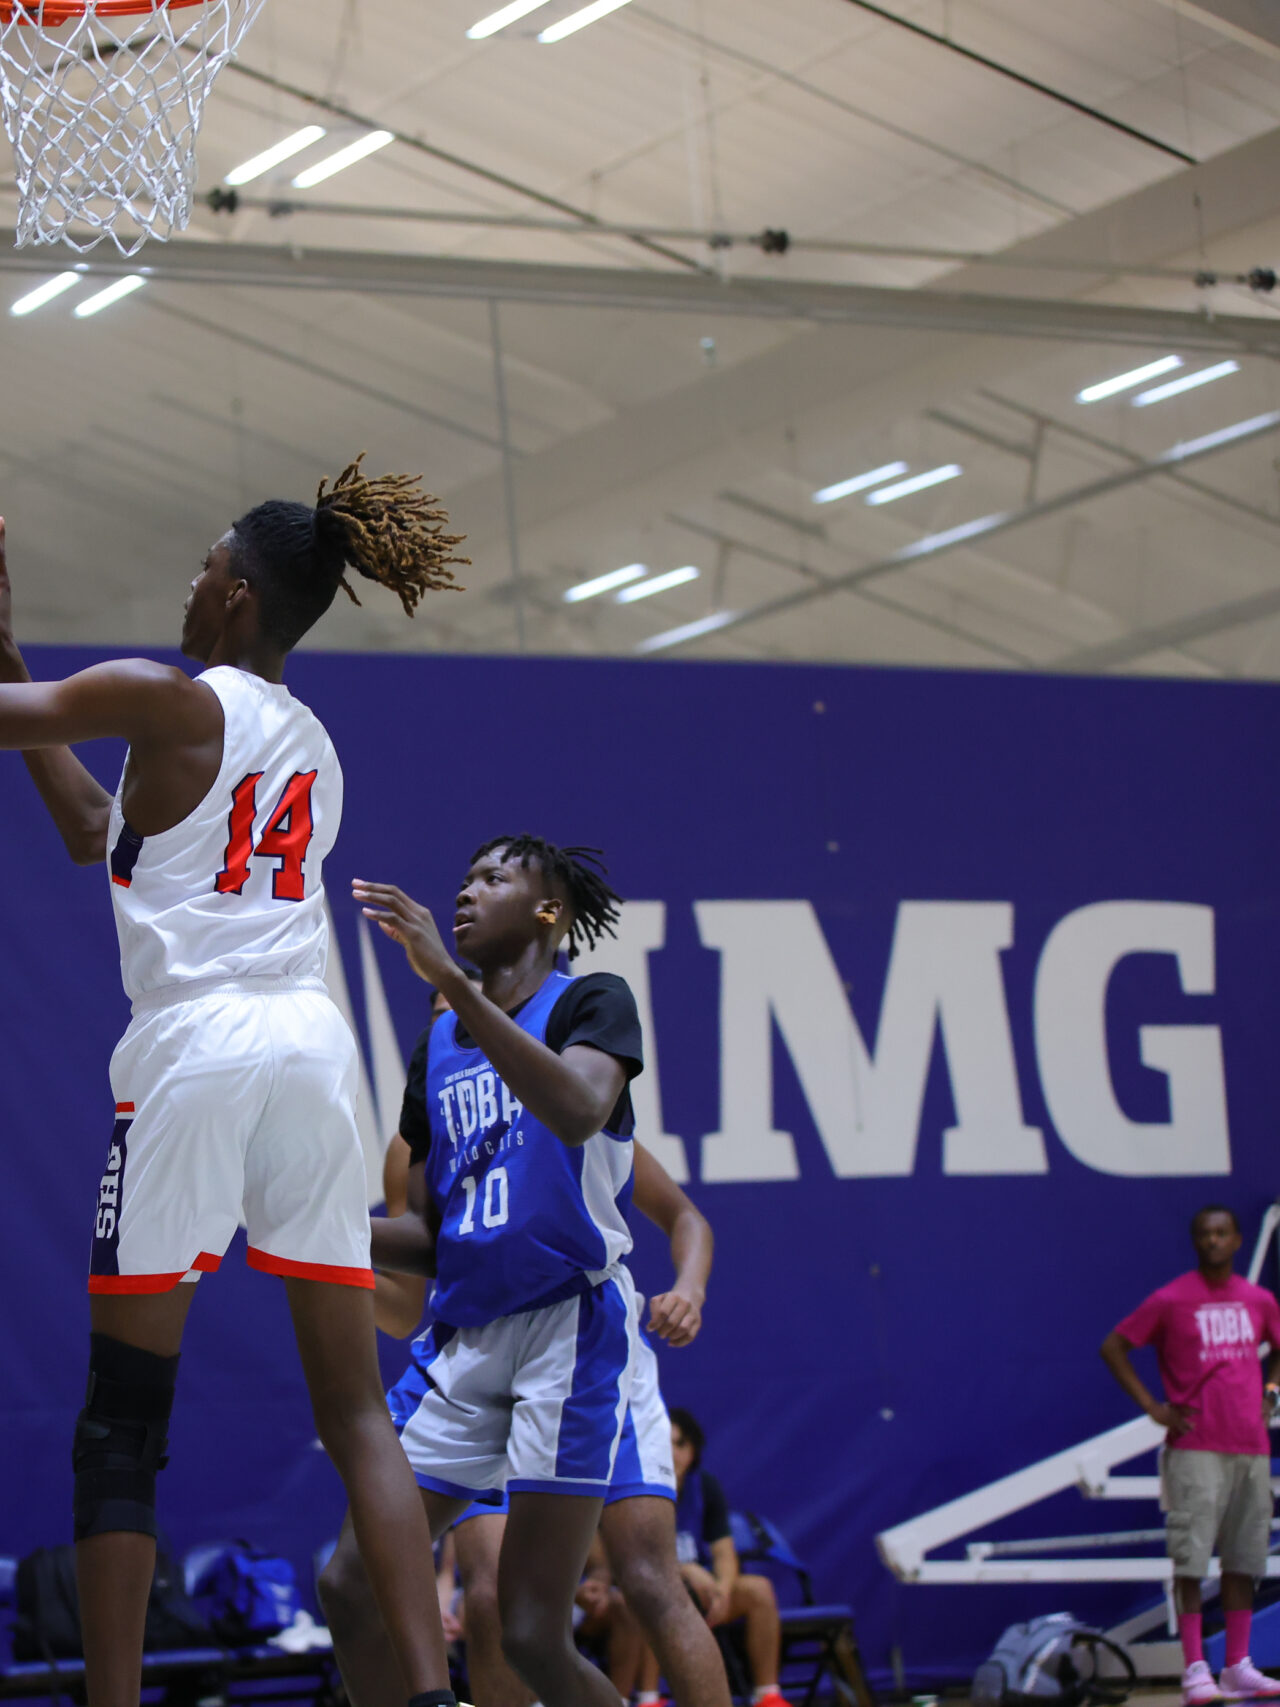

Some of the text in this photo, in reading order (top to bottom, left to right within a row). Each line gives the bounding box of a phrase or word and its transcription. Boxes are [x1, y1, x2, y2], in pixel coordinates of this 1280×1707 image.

[214, 769, 318, 901] 14
[459, 1166, 509, 1235] 10
[1194, 1308, 1255, 1346] TDBA
